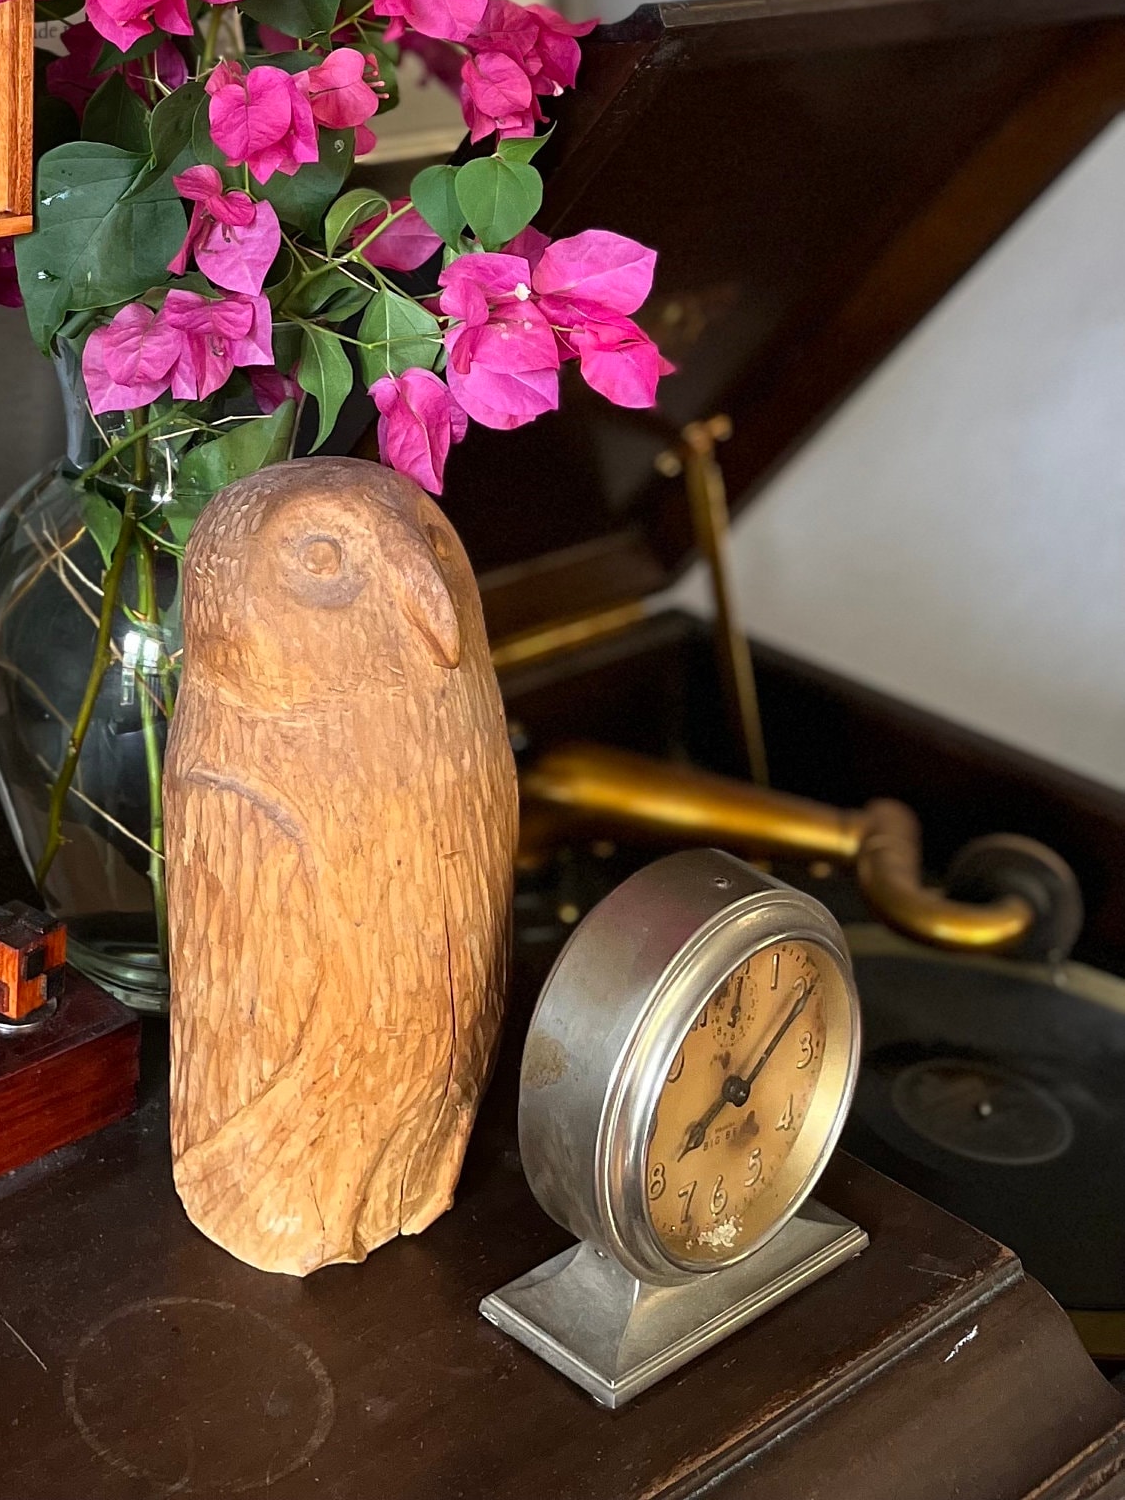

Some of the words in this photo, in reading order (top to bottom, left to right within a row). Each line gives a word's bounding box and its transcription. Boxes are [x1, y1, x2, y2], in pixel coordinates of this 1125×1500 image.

[796, 1031, 814, 1069] 3
[775, 1094, 794, 1132] 4
[703, 1135, 721, 1152] BIG
[648, 1162, 666, 1201] 8
[743, 1147, 763, 1187] 5
[677, 1180, 698, 1224] 7
[709, 1174, 728, 1216] 6
